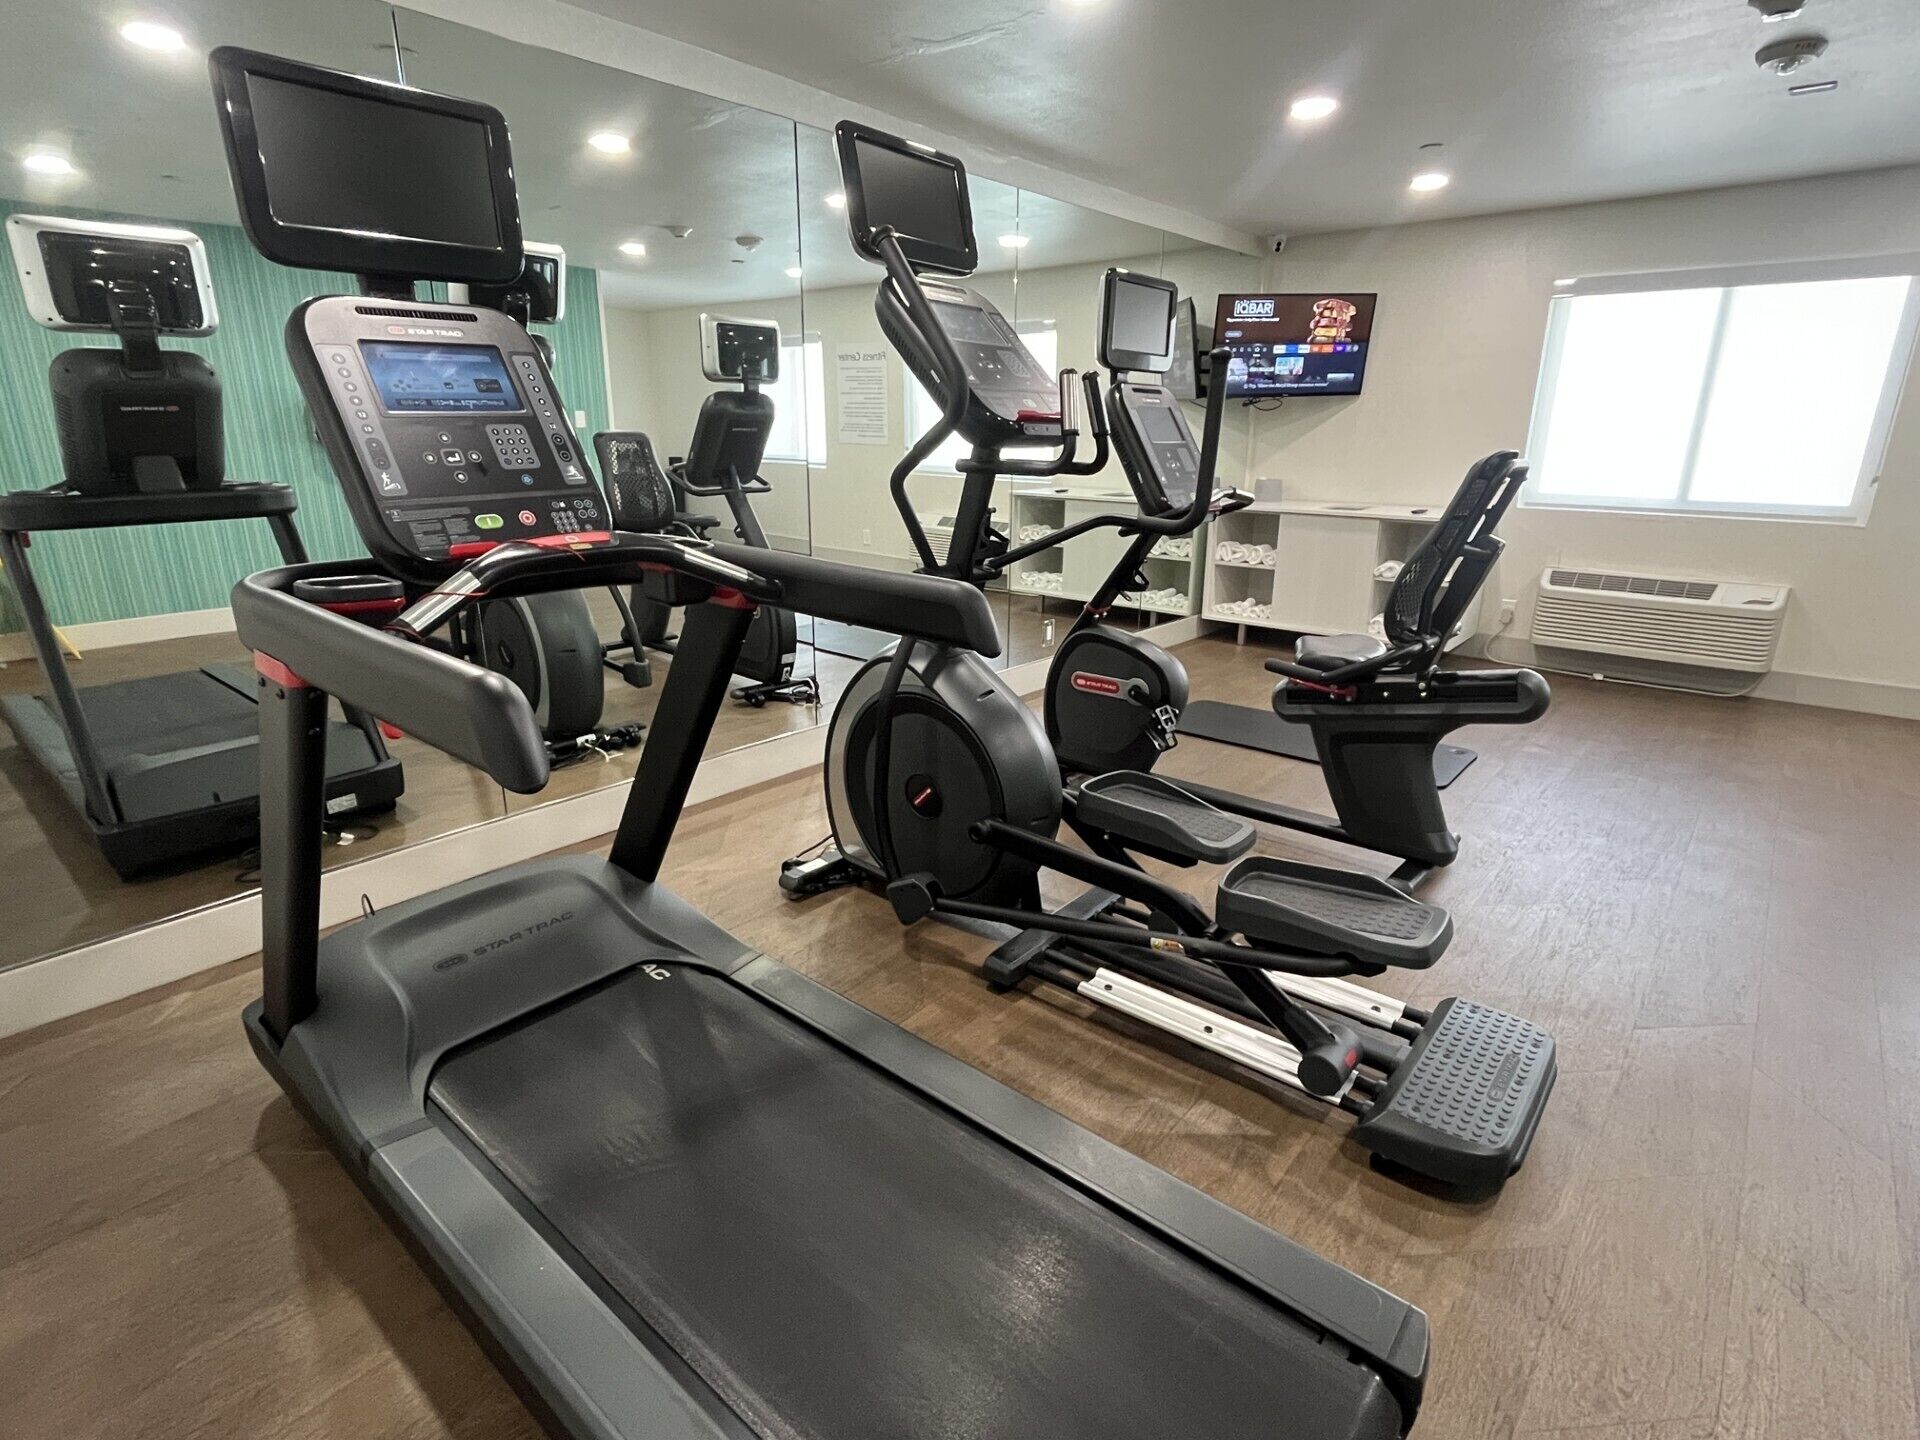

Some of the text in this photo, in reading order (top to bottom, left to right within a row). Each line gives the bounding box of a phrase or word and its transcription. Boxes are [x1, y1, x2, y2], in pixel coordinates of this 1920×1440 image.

[1236, 301, 1272, 314] IQBAR
[473, 911, 574, 955] STAR TRAC
